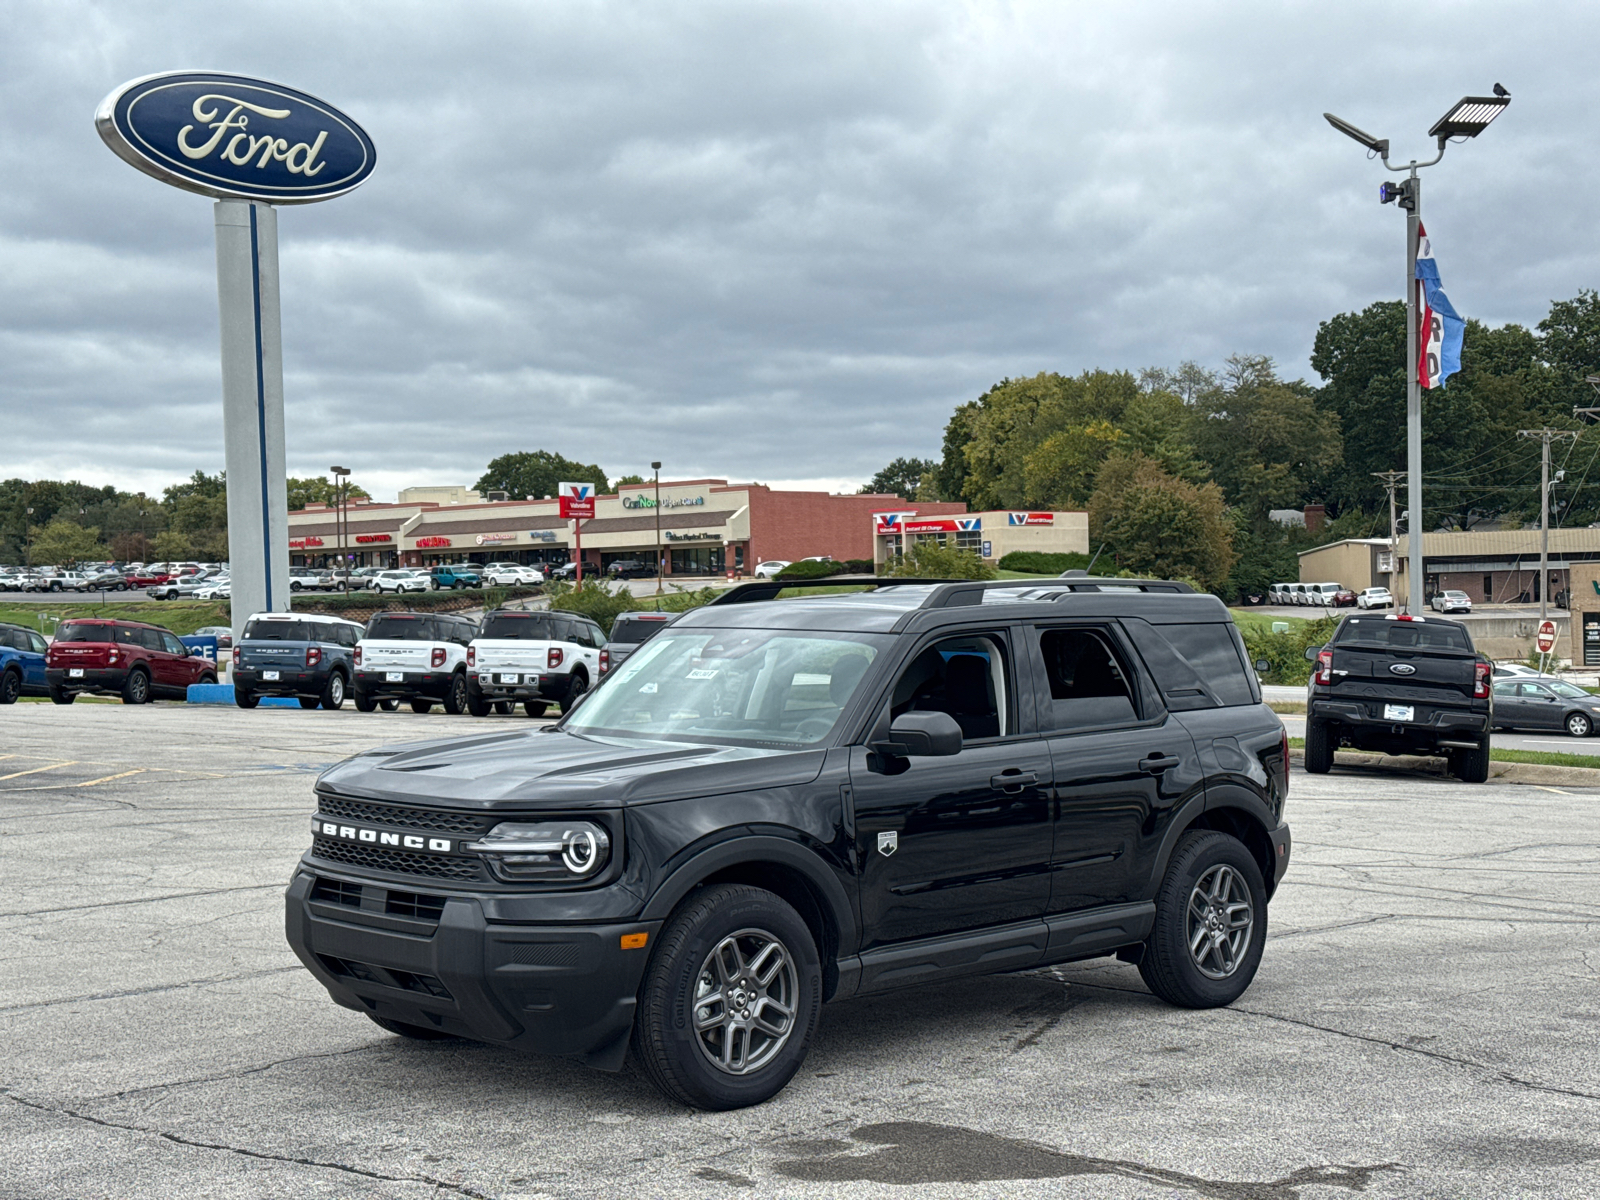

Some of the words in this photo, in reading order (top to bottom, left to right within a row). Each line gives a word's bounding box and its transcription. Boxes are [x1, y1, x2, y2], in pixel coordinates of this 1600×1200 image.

[177, 94, 328, 177] Ford
[661, 499, 681, 509] Urgent
[323, 823, 451, 852] BRONCO
[675, 957, 696, 1030] Continental
